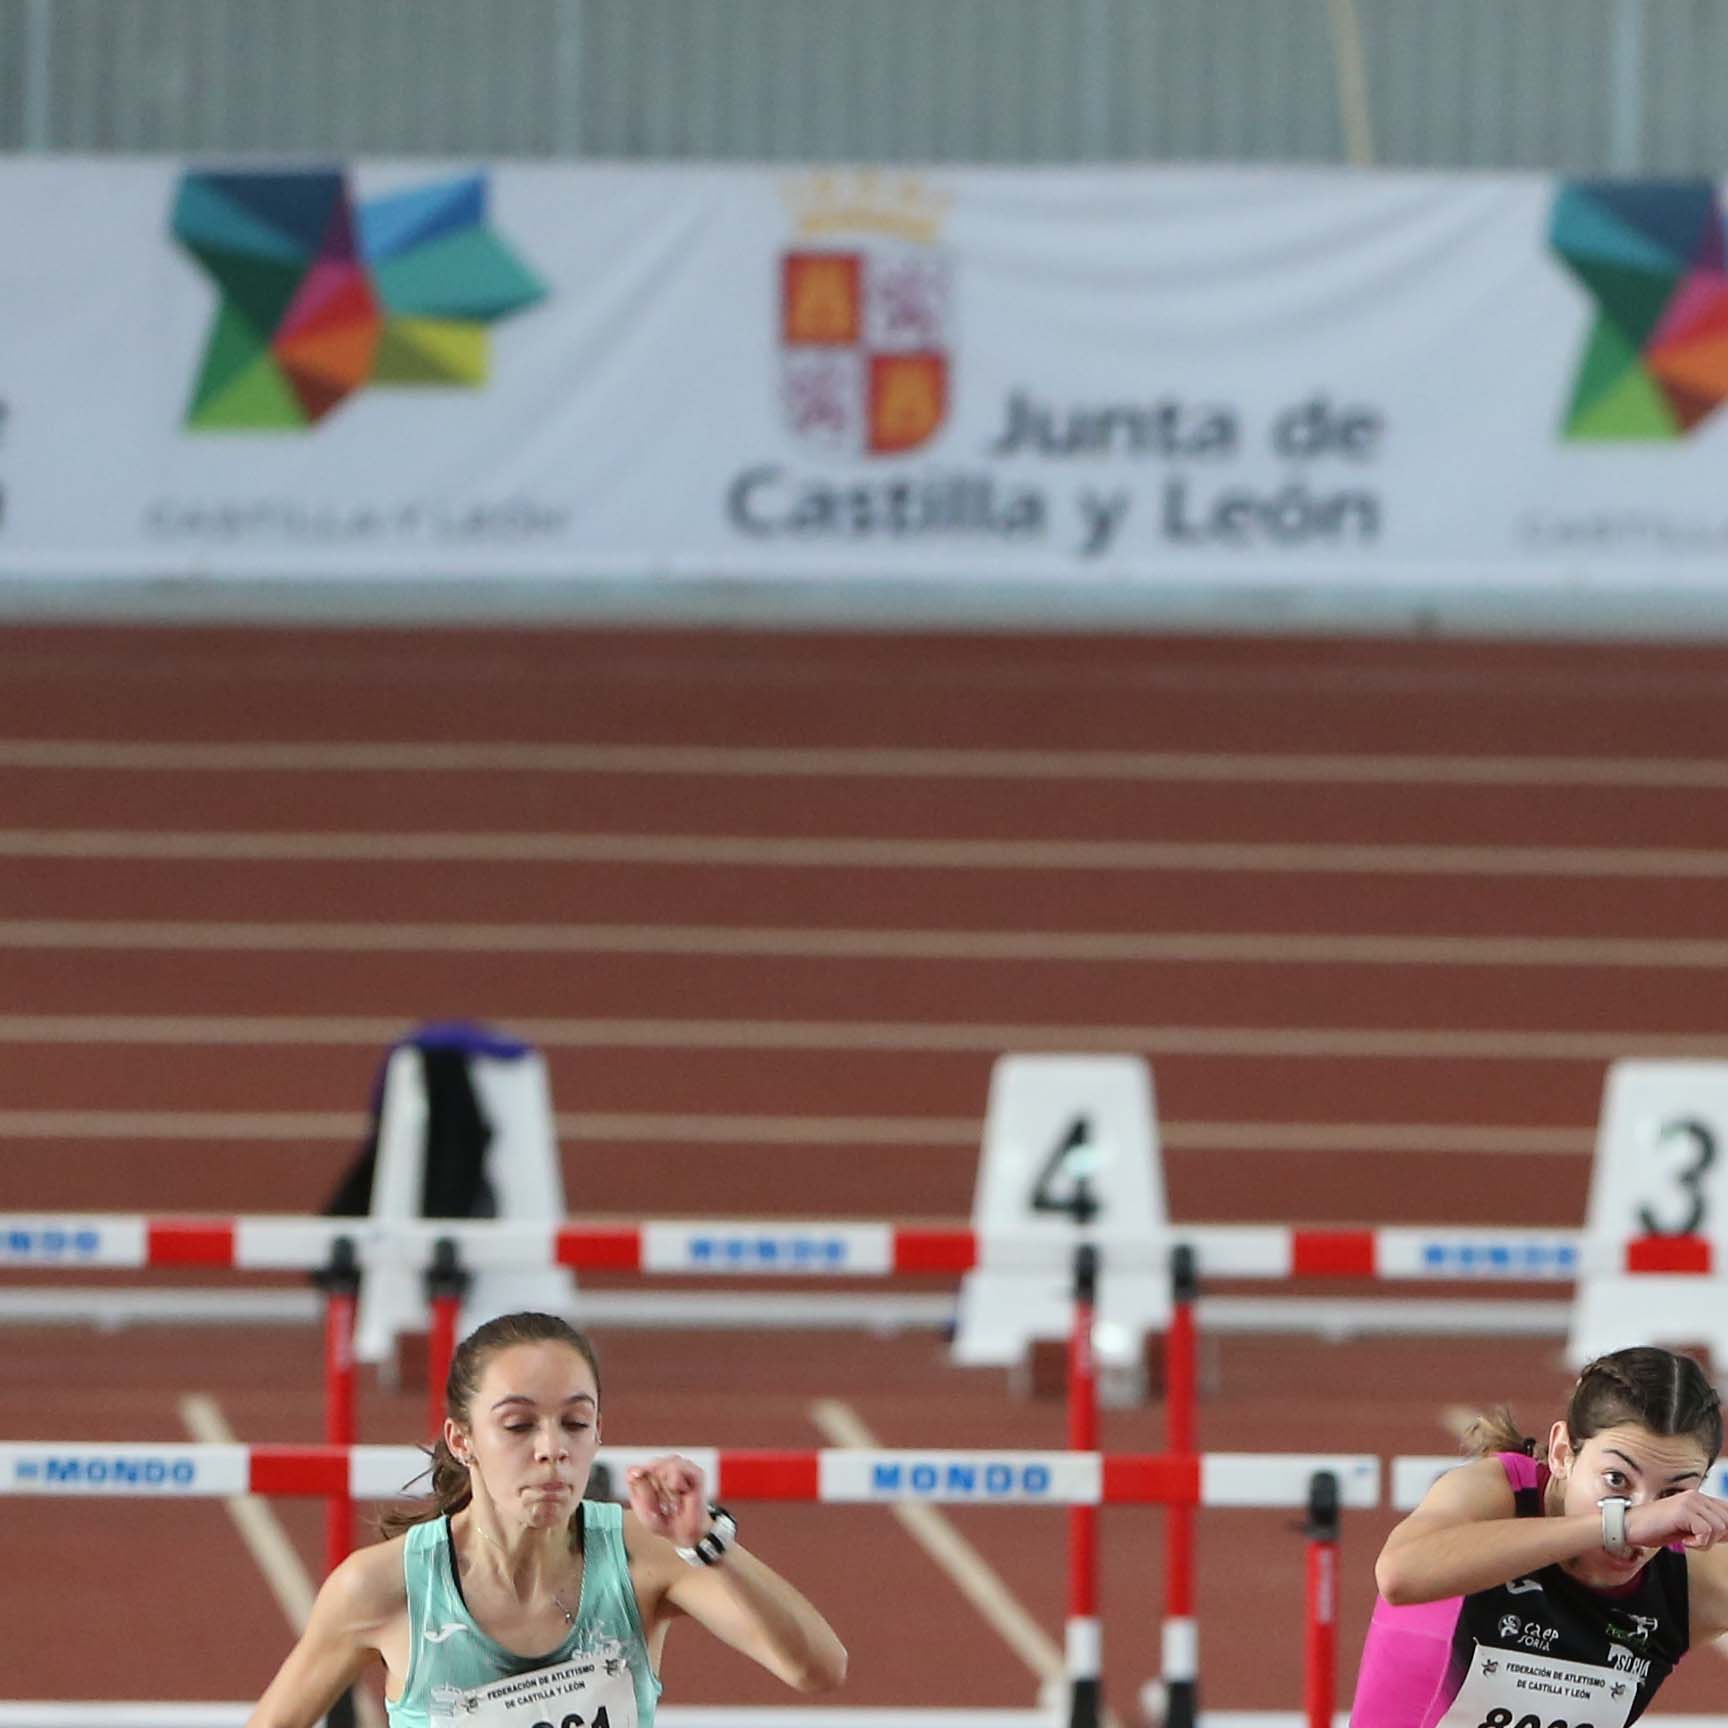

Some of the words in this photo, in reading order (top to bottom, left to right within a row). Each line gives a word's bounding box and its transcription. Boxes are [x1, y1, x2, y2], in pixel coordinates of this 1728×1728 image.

[992, 388, 1240, 460] Junta
[1272, 393, 1385, 460] de
[725, 466, 1046, 539] Castilla
[1080, 489, 1128, 559] y
[1162, 475, 1383, 544] León
[1031, 1114, 1104, 1225] 4
[1636, 1118, 1718, 1237] 3
[46, 1458, 196, 1485] MONDO
[872, 1463, 1053, 1494] MONDO
[487, 1679, 538, 1700] FEDERACIÓN
[539, 1675, 550, 1686] DE
[551, 1664, 596, 1683] ATLETISMO
[1506, 1662, 1552, 1680] FEDERACIÓN
[1553, 1669, 1564, 1681] DE
[1564, 1673, 1607, 1689] ATLETISMO
[1516, 1679, 1527, 1689] DE
[1528, 1681, 1562, 1696] CASTILLA
[1571, 1688, 1592, 1700] LEÓN
[505, 1698, 515, 1710] DE
[517, 1689, 557, 1706] CASTILLA
[564, 1681, 586, 1694] LEÓN
